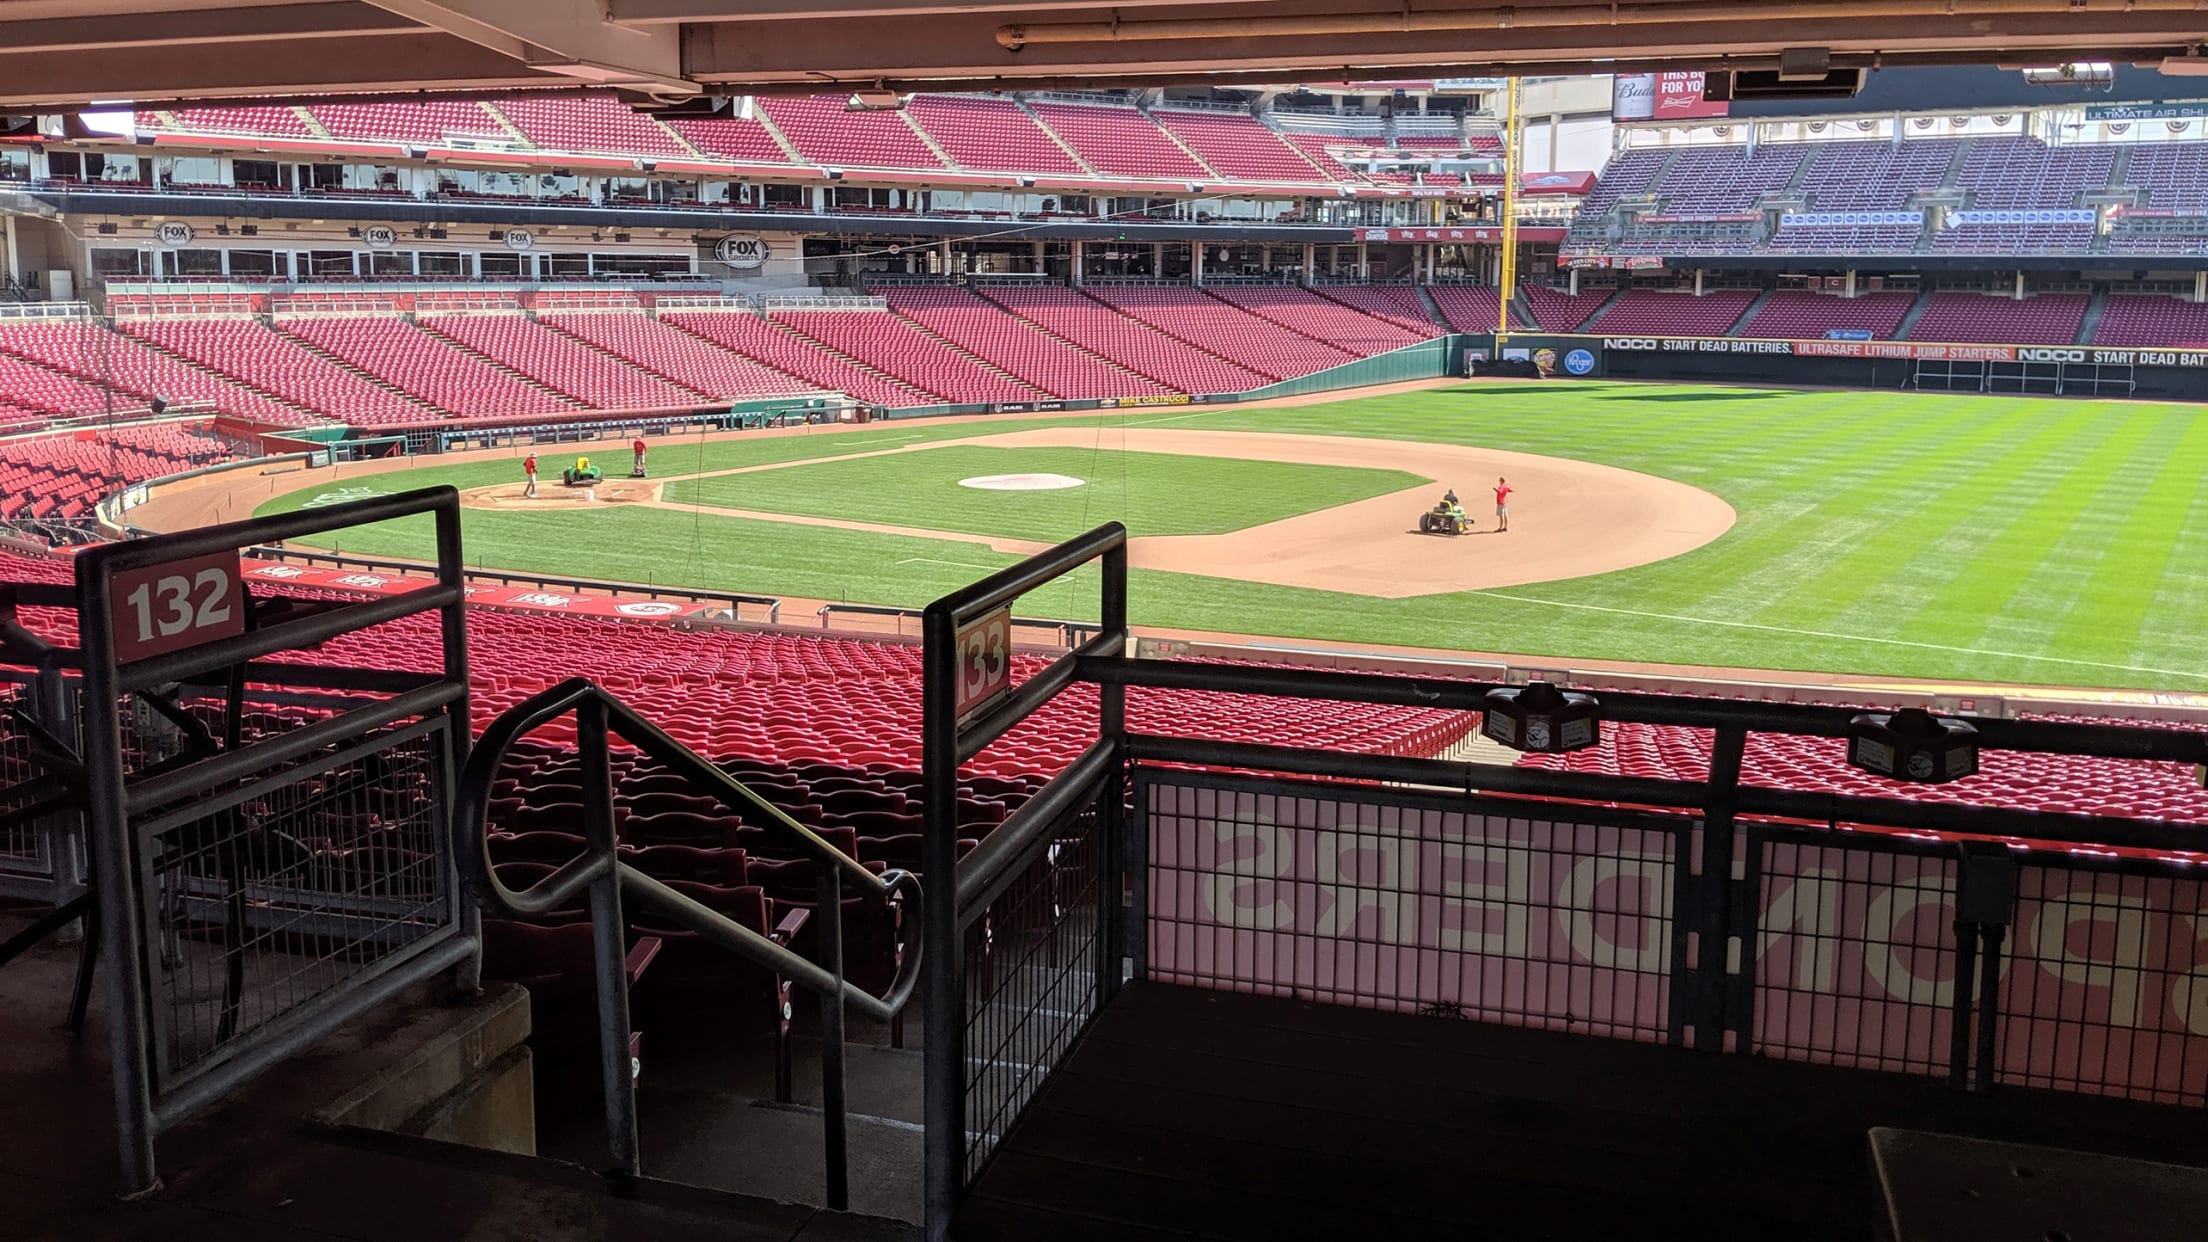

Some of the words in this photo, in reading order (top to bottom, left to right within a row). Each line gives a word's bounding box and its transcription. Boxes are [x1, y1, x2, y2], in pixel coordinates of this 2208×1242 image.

[1663, 72, 1687, 80] THIS
[1661, 82, 1684, 93] FOR
[1686, 81, 1704, 92] YO
[2088, 110, 2152, 119] ULTIMATE
[2155, 109, 2177, 117] AIR
[164, 226, 187, 237] FOX
[370, 230, 390, 240] FOX
[510, 232, 528, 241] FOX
[727, 240, 758, 255] FOX
[1604, 338, 1657, 350] NOCO
[1663, 340, 1697, 351] START
[1699, 341, 1728, 352] DEAD
[1798, 343, 1860, 356] ULTRASAFE
[1865, 345, 1911, 357] LITHIUM
[1913, 346, 1946, 358] JUMP
[1948, 348, 2012, 360] STARTERS.
[2018, 349, 2085, 362] NOCO
[2093, 352, 2136, 364] START
[2139, 353, 2177, 365] DEAD
[1568, 353, 1592, 371] Kroger
[1119, 396, 1141, 405] MIKE
[127, 567, 231, 642] 132
[956, 621, 1004, 706] 133
